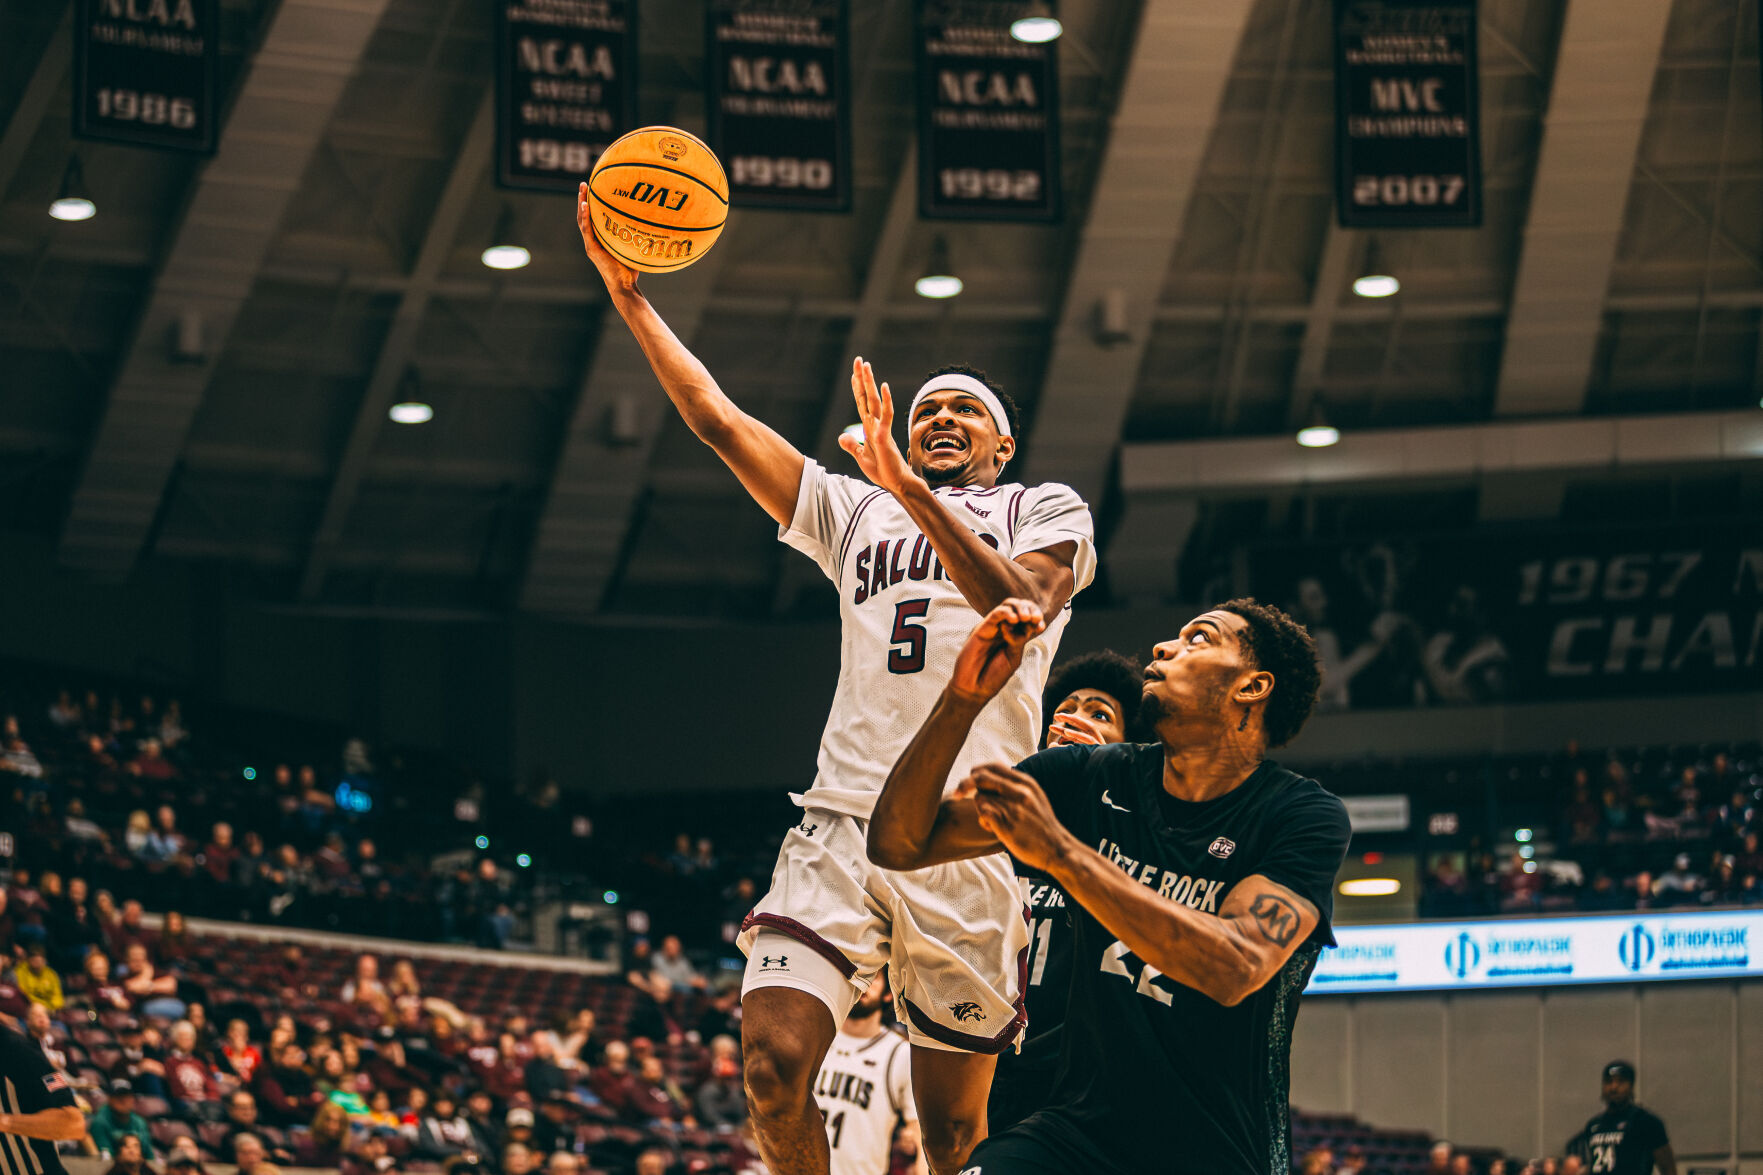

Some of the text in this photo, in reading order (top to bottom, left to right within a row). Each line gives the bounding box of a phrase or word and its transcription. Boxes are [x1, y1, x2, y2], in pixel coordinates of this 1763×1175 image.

[518, 37, 615, 80] NCAA
[729, 56, 828, 96] NCAA
[97, 87, 196, 129] 1986
[938, 69, 1037, 107] NCAA
[1370, 77, 1446, 113] MVC
[612, 187, 630, 198] NXT
[731, 155, 833, 190] 1990
[940, 168, 1042, 201] 1992
[1353, 174, 1465, 206] 2007
[604, 214, 693, 259] Wilson
[854, 529, 999, 605] SALU
[1518, 552, 1702, 605] 1967
[887, 597, 932, 675] 5
[1547, 612, 1763, 676] CHA
[1157, 870, 1225, 913] ROCK
[818, 1069, 875, 1110] LUKIS
[1591, 1145, 1617, 1174] 24
